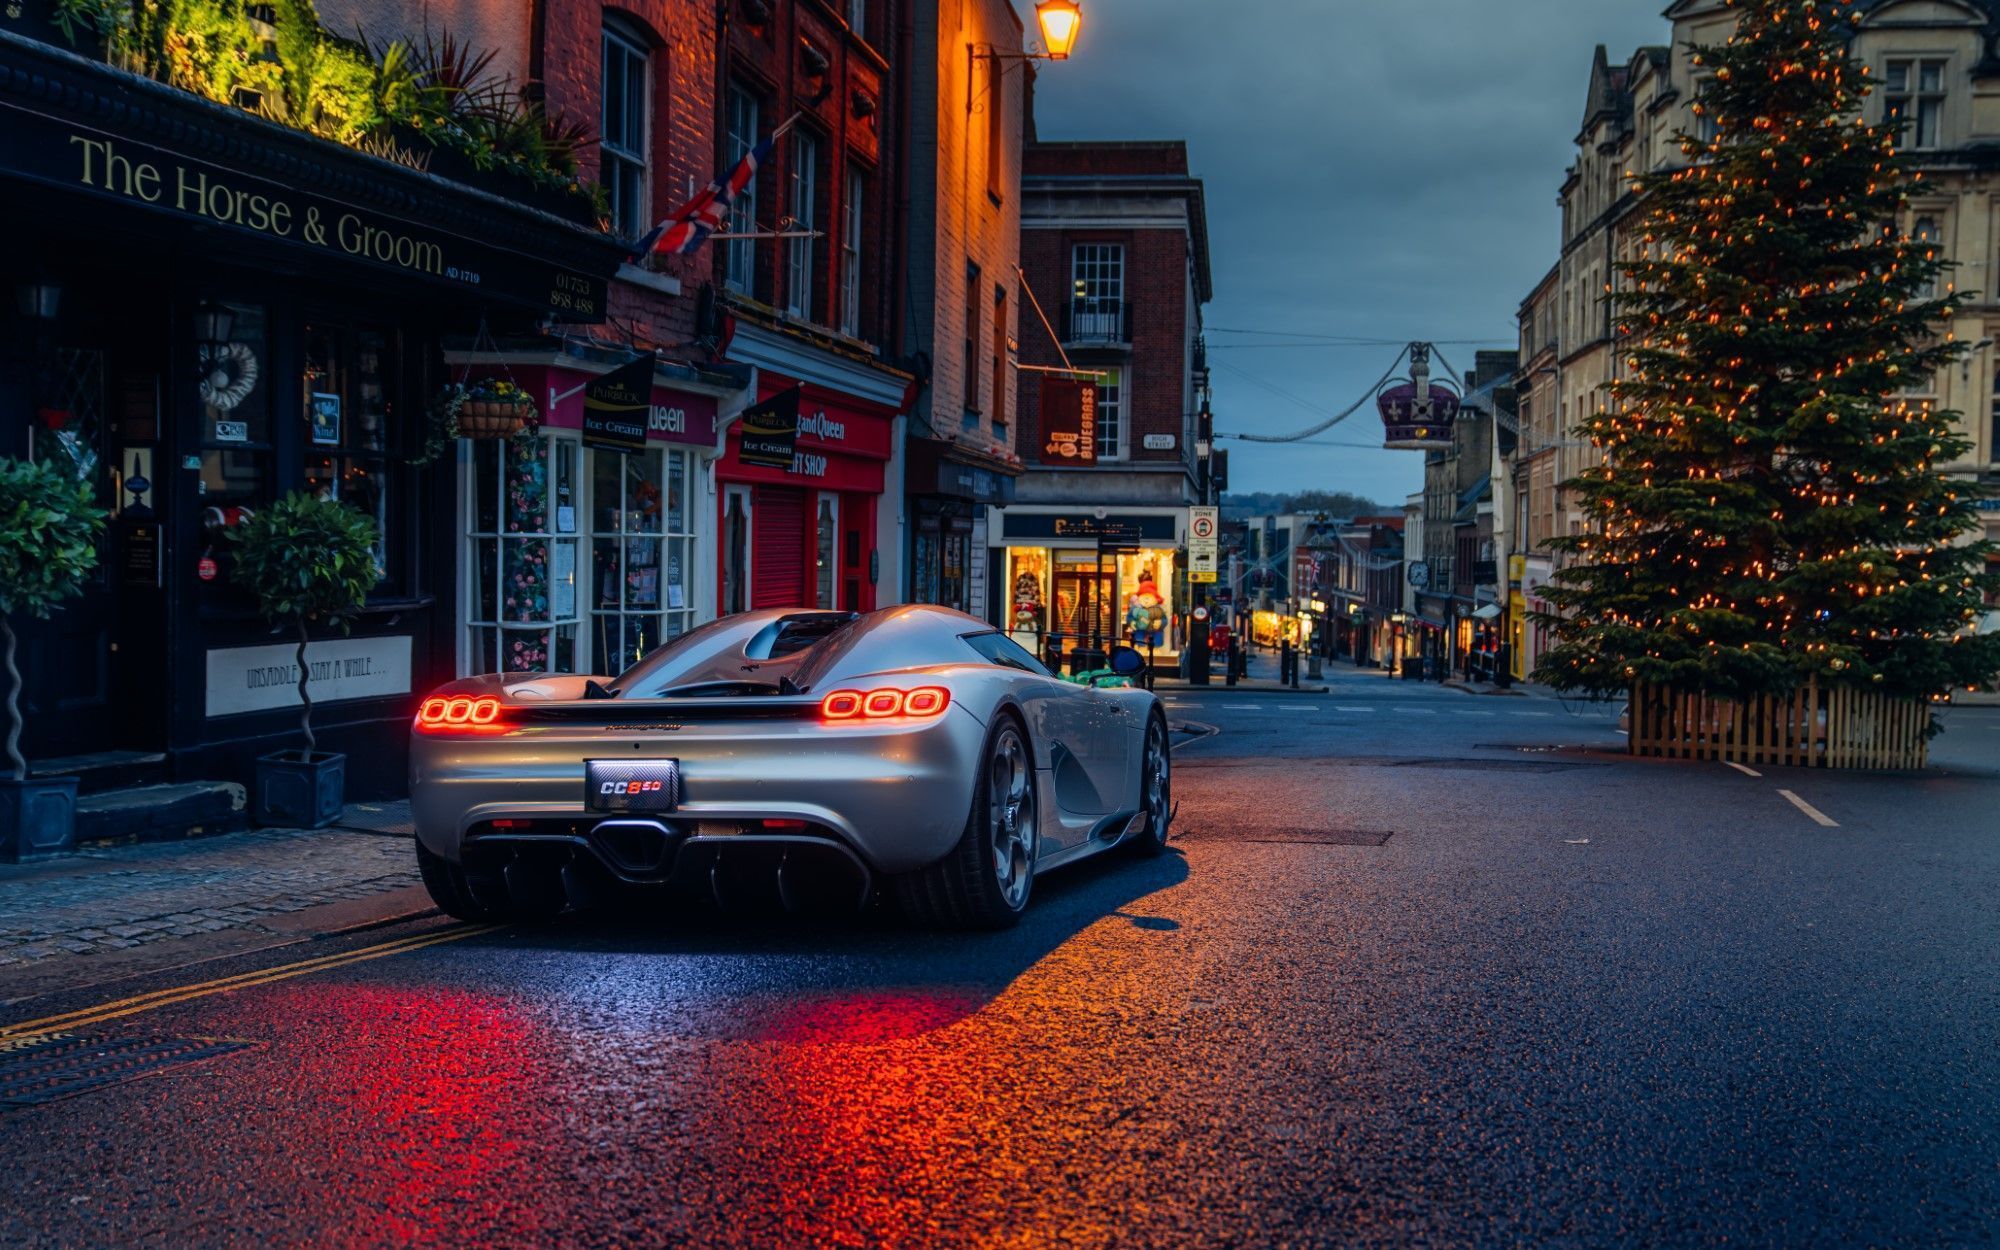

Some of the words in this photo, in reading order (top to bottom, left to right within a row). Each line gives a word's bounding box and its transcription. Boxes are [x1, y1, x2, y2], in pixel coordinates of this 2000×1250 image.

[69, 134, 163, 203] The
[176, 165, 293, 237] Horse
[303, 206, 328, 247] &
[337, 213, 443, 275] Groom
[445, 266, 458, 279] AD
[460, 269, 480, 284] 1719
[556, 272, 590, 295] 01753
[550, 290, 572, 310] 868
[574, 298, 594, 315] 488
[585, 417, 603, 431] Ice
[605, 420, 643, 437] Cream
[648, 404, 685, 433] ueen
[817, 411, 845, 440] Queen
[1080, 387, 1095, 460] BLUEGRASS
[743, 440, 759, 450] Ice
[760, 442, 792, 455] Cream
[805, 453, 827, 477] SHOP
[247, 664, 297, 689] UNSADDLE
[309, 660, 332, 682] STAY
[333, 659, 342, 679] A
